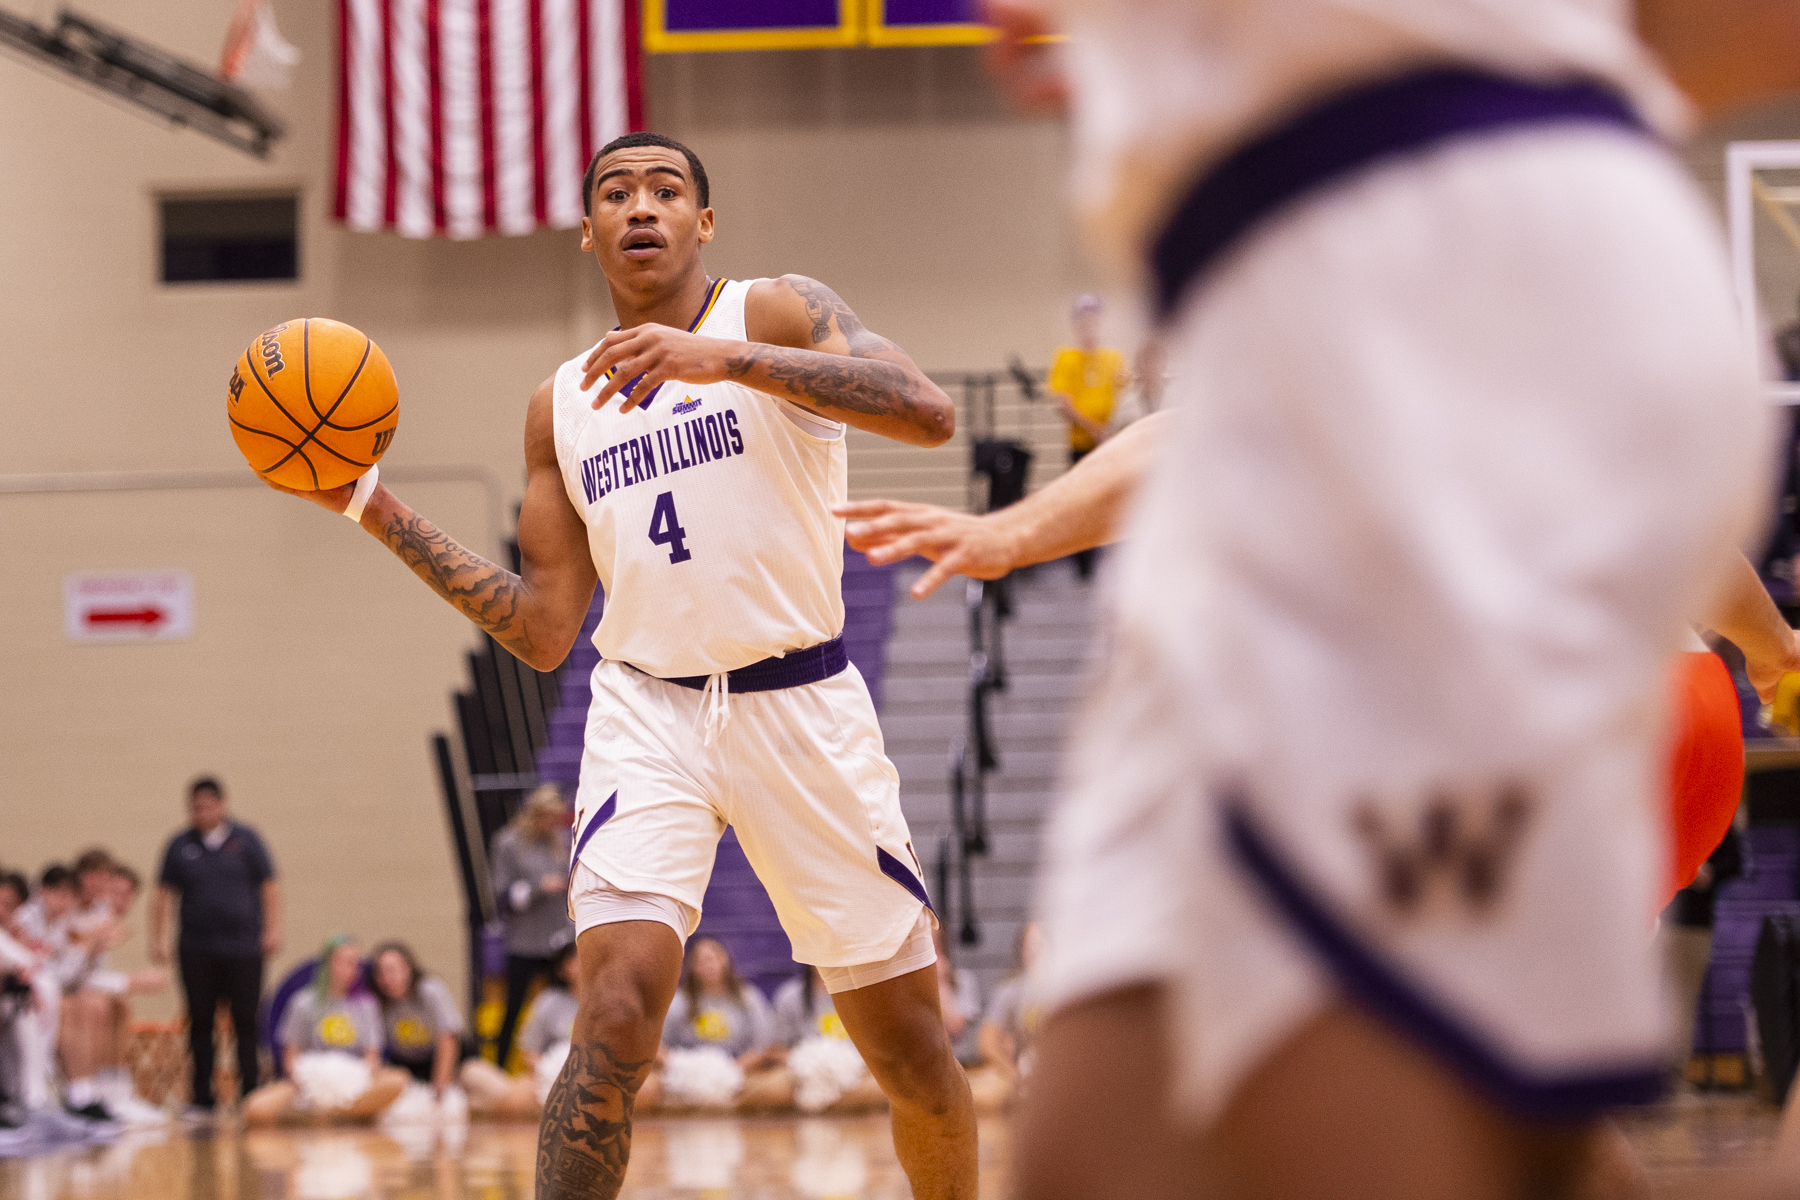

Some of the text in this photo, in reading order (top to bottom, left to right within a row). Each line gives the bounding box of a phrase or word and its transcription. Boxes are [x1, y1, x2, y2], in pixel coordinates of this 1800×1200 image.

[672, 398, 702, 415] SUMMIT
[580, 409, 745, 505] WESTERN ILLINOIS
[648, 490, 692, 565] 4
